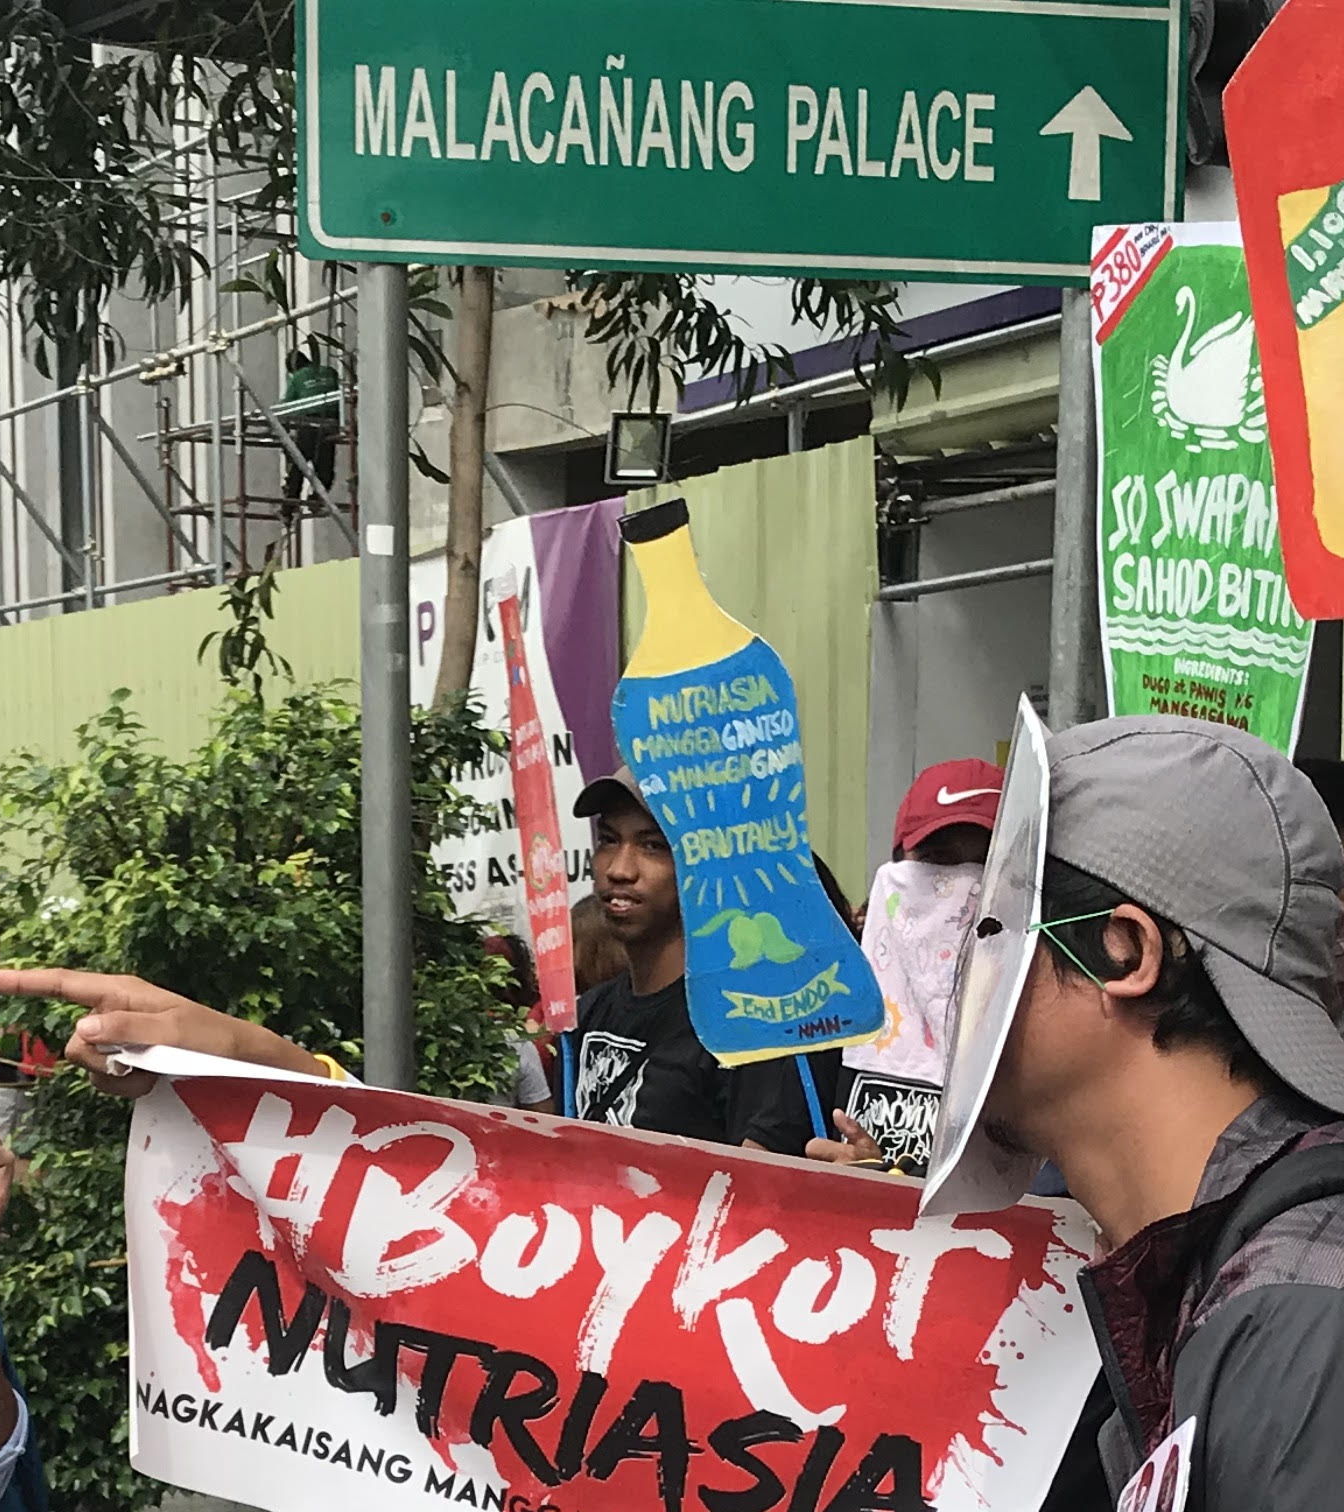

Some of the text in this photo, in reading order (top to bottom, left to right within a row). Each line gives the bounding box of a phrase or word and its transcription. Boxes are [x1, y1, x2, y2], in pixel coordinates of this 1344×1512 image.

[354, 54, 996, 182] MALACAÑANG PALACE
[1112, 552, 1214, 618] SAHOD
[224, 1089, 1013, 1432] #Boykot
[136, 1380, 413, 1484] NAGKAKAISANG
